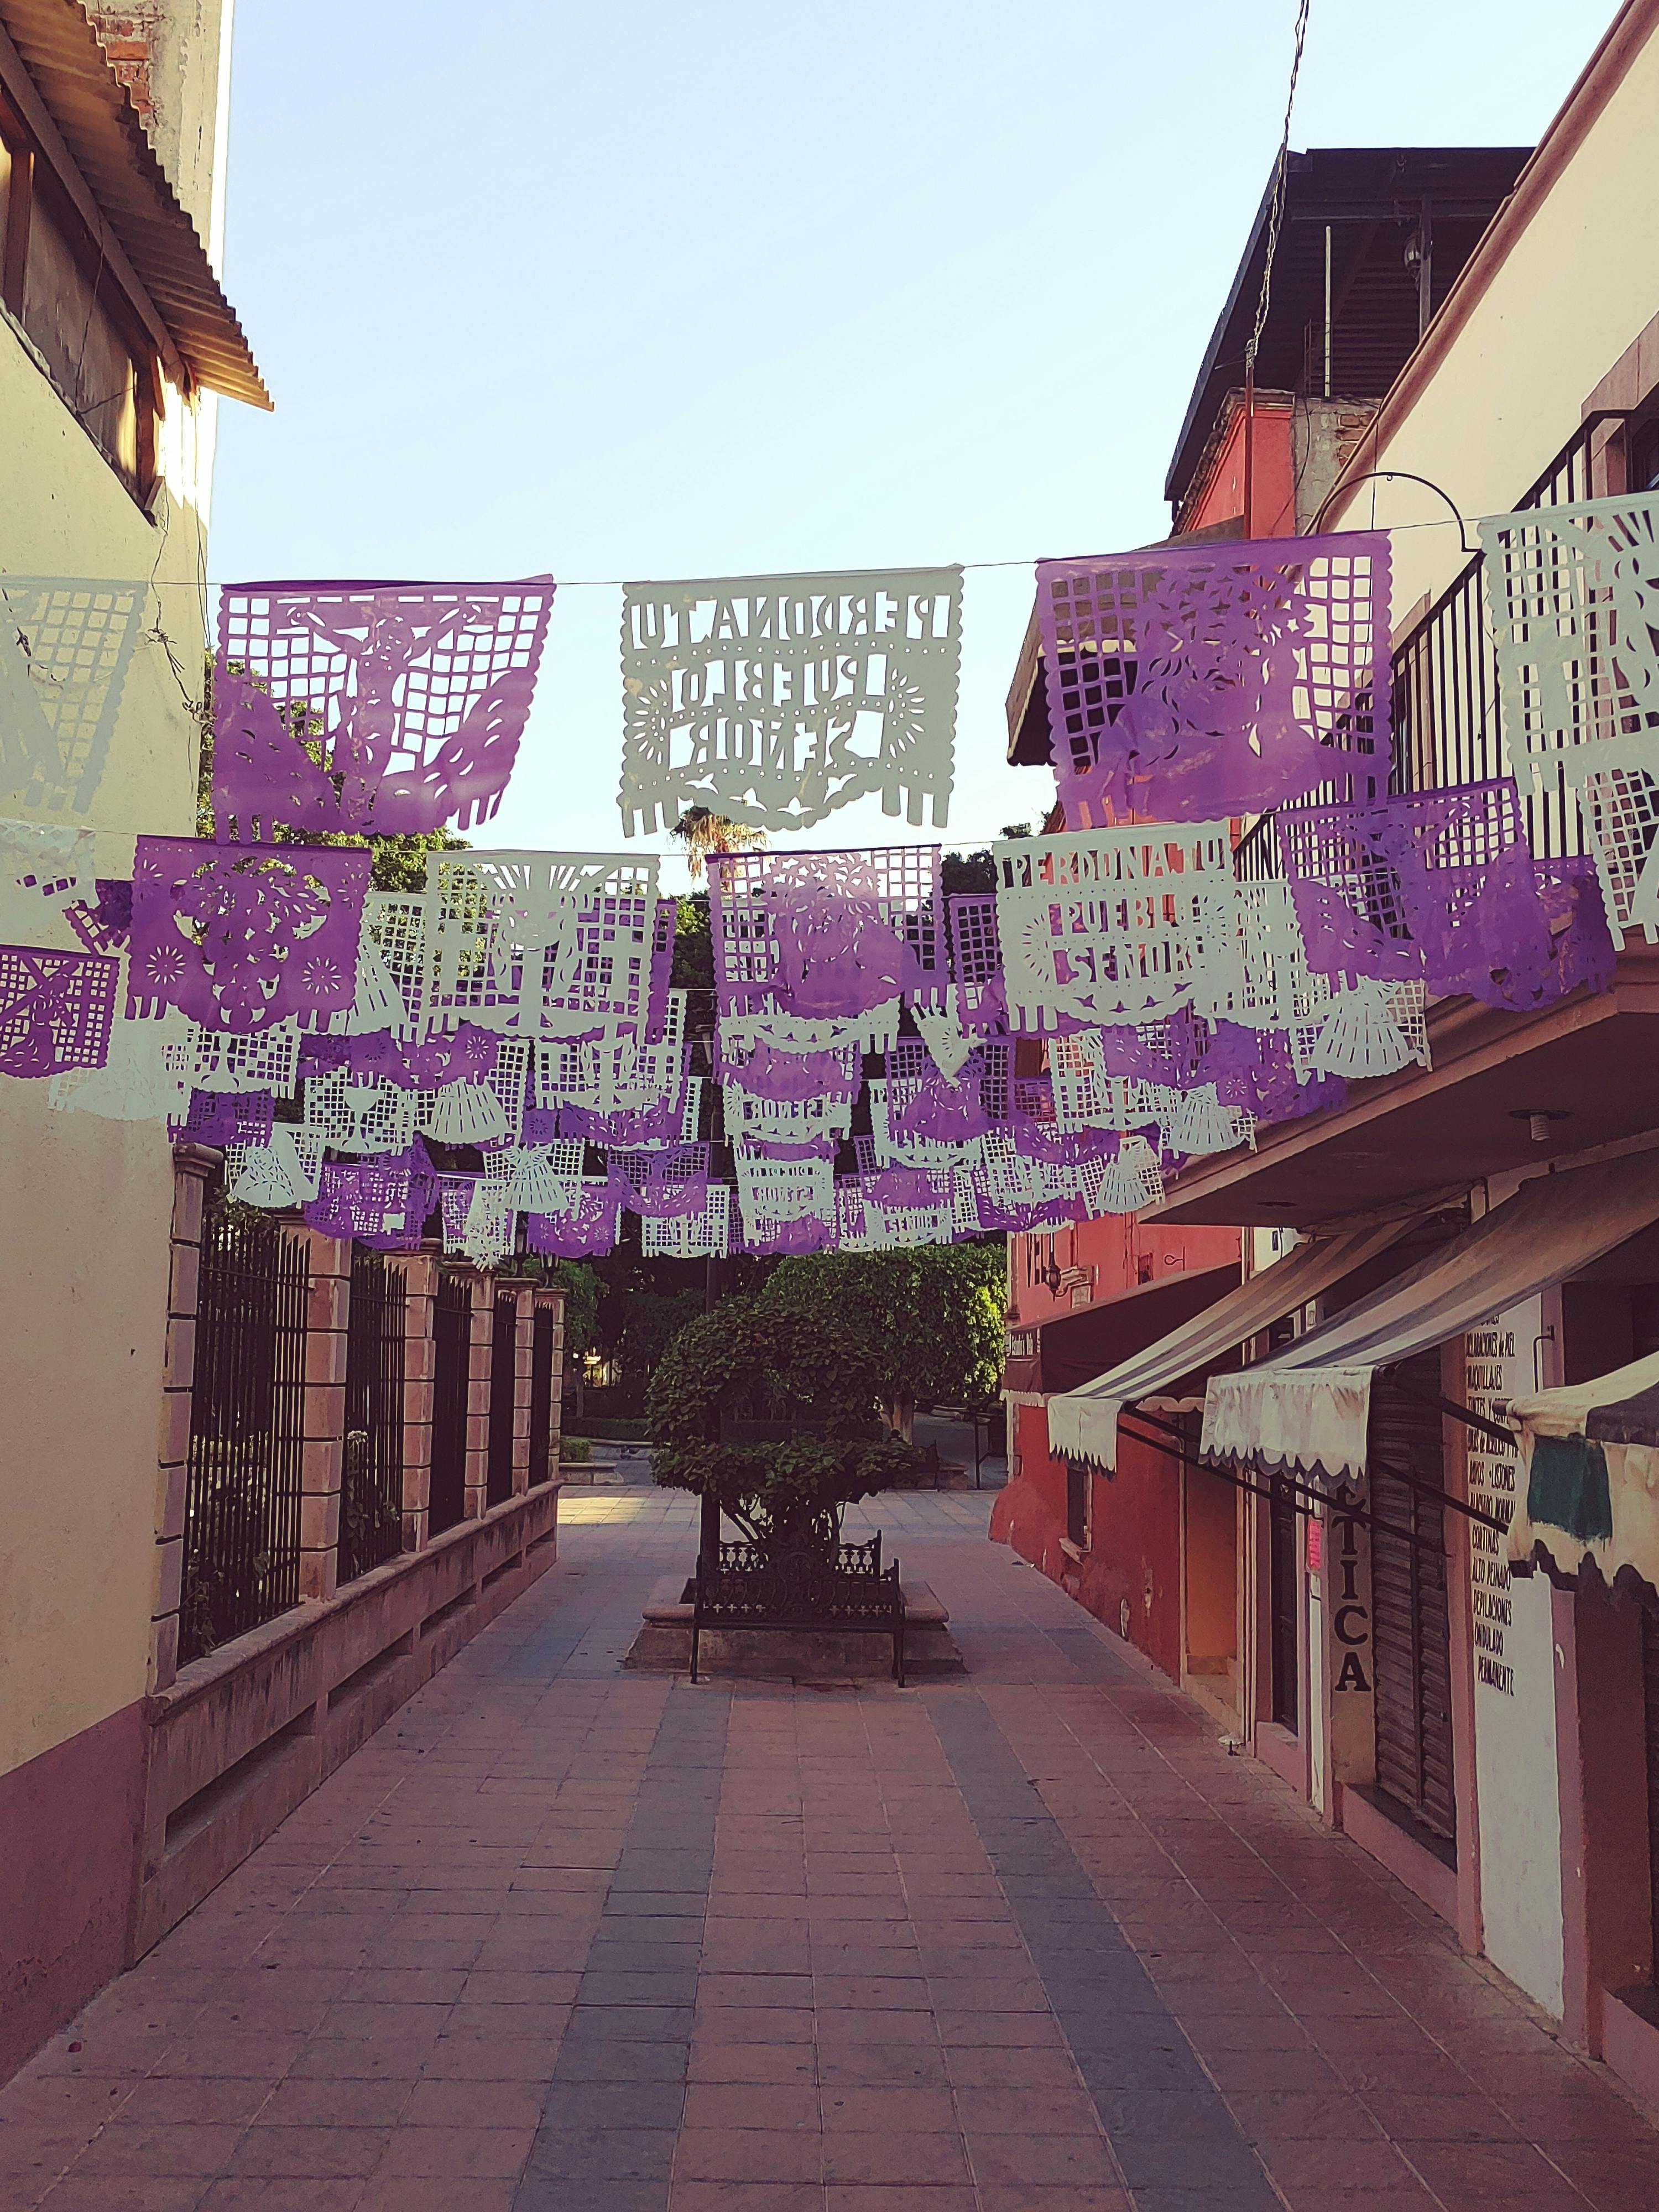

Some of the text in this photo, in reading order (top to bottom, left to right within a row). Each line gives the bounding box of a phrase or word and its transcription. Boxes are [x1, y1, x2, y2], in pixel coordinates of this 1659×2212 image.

[1472, 1524, 1499, 1556] CORTINAS
[1472, 1557, 1511, 1592] ALTO PEINADO
[1473, 1589, 1512, 1627] DEPILACIONES
[1475, 1621, 1504, 1657] ONDULADO
[1478, 1655, 1514, 1697] PERMANENTE
